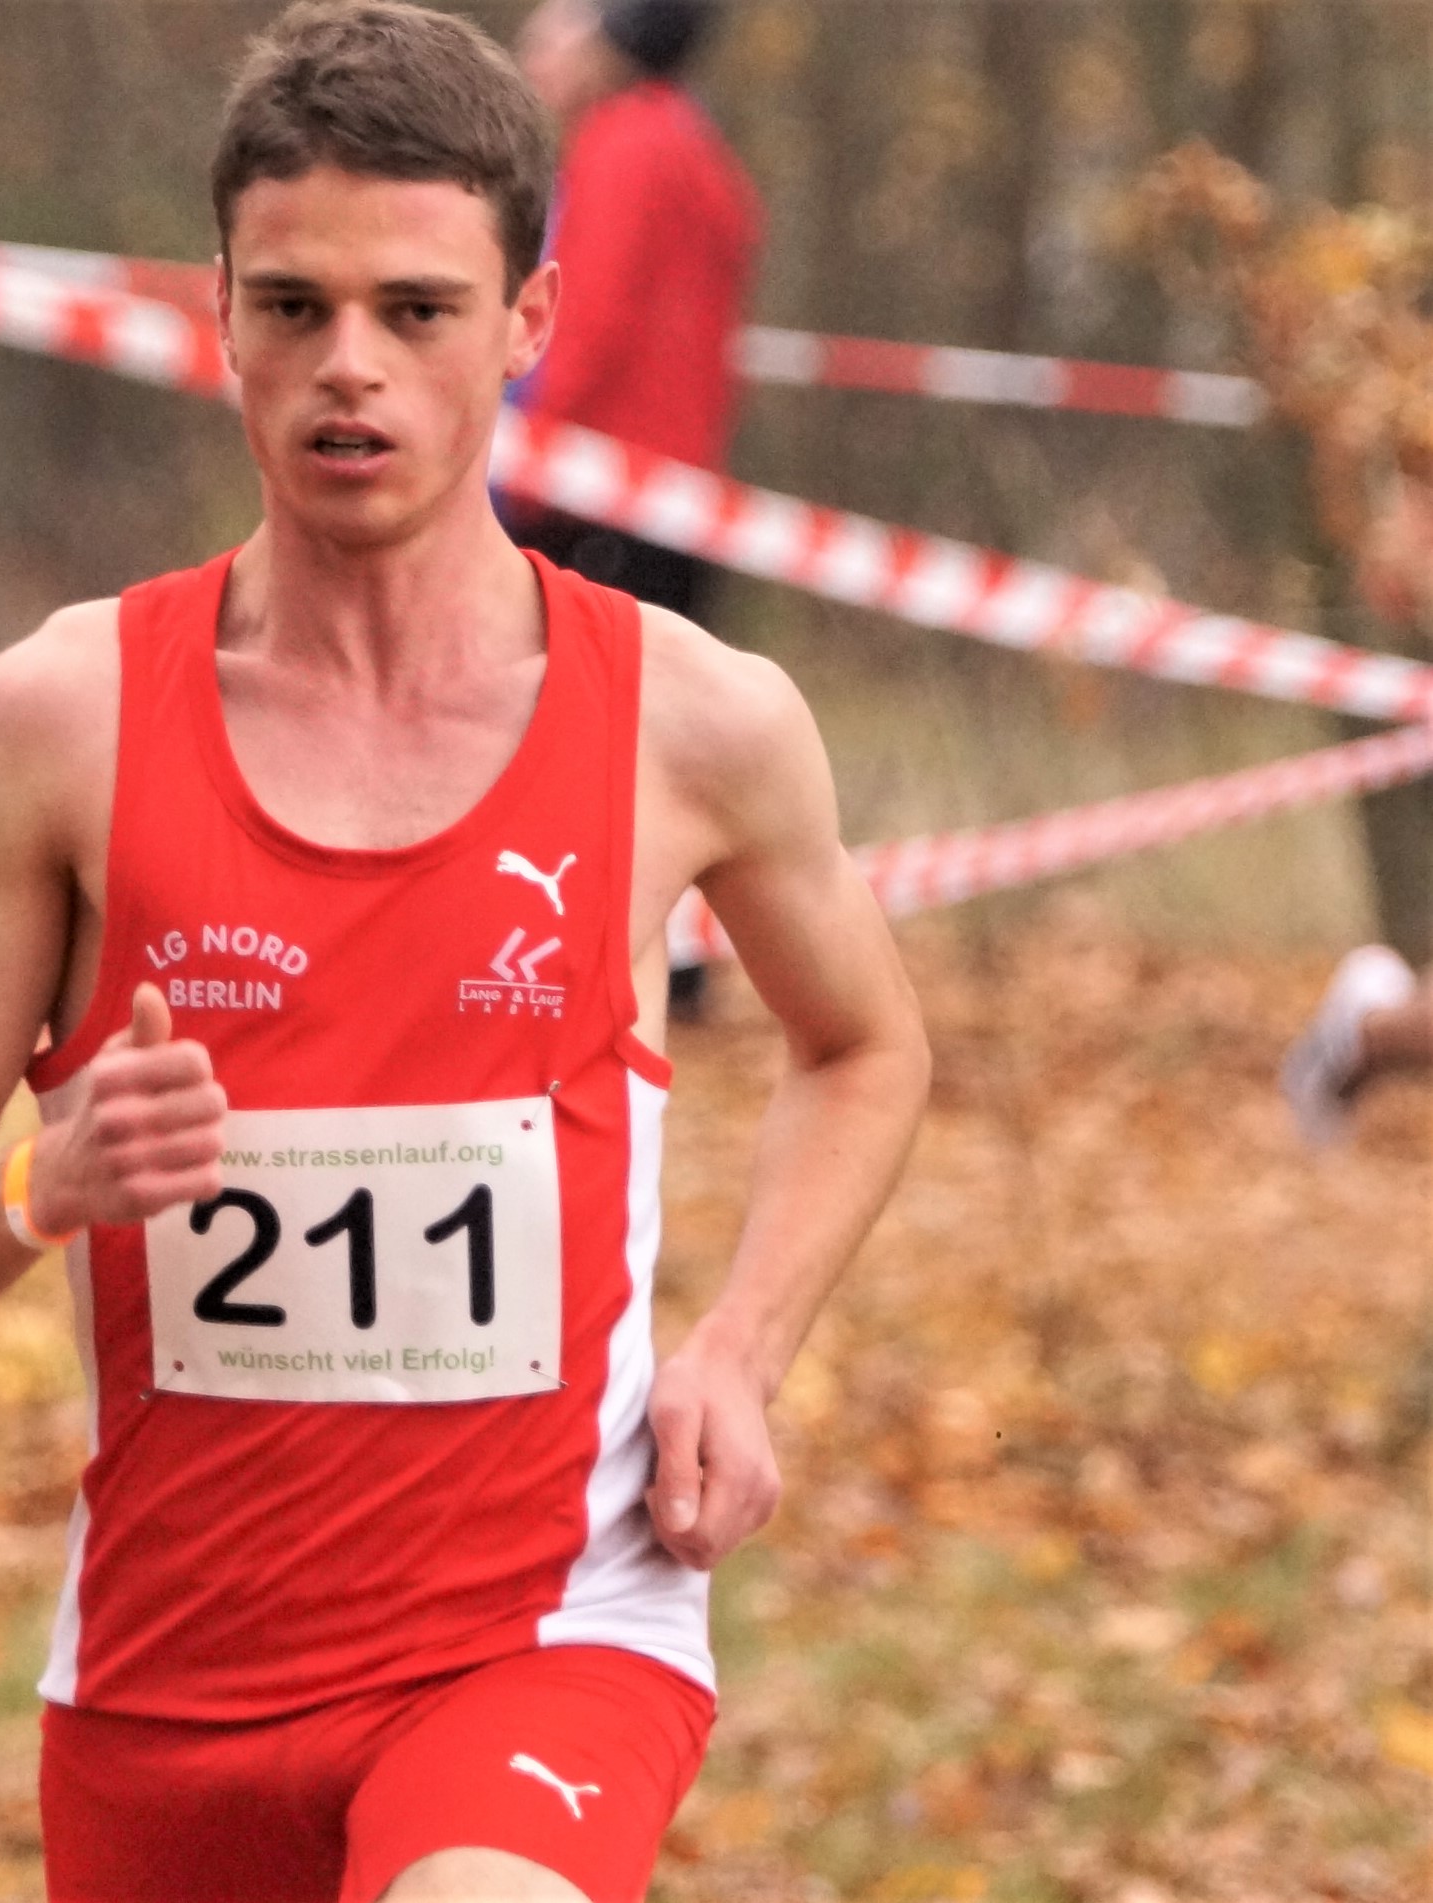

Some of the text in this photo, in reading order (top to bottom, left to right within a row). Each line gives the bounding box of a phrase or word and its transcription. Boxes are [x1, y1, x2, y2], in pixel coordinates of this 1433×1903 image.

[147, 924, 308, 975] LG NORD
[169, 979, 281, 1009] BERLIN
[219, 1142, 503, 1168] ww.strassenlauf.org
[190, 1183, 495, 1329] 211
[219, 1346, 495, 1374] wünscht viel Erfolg!
